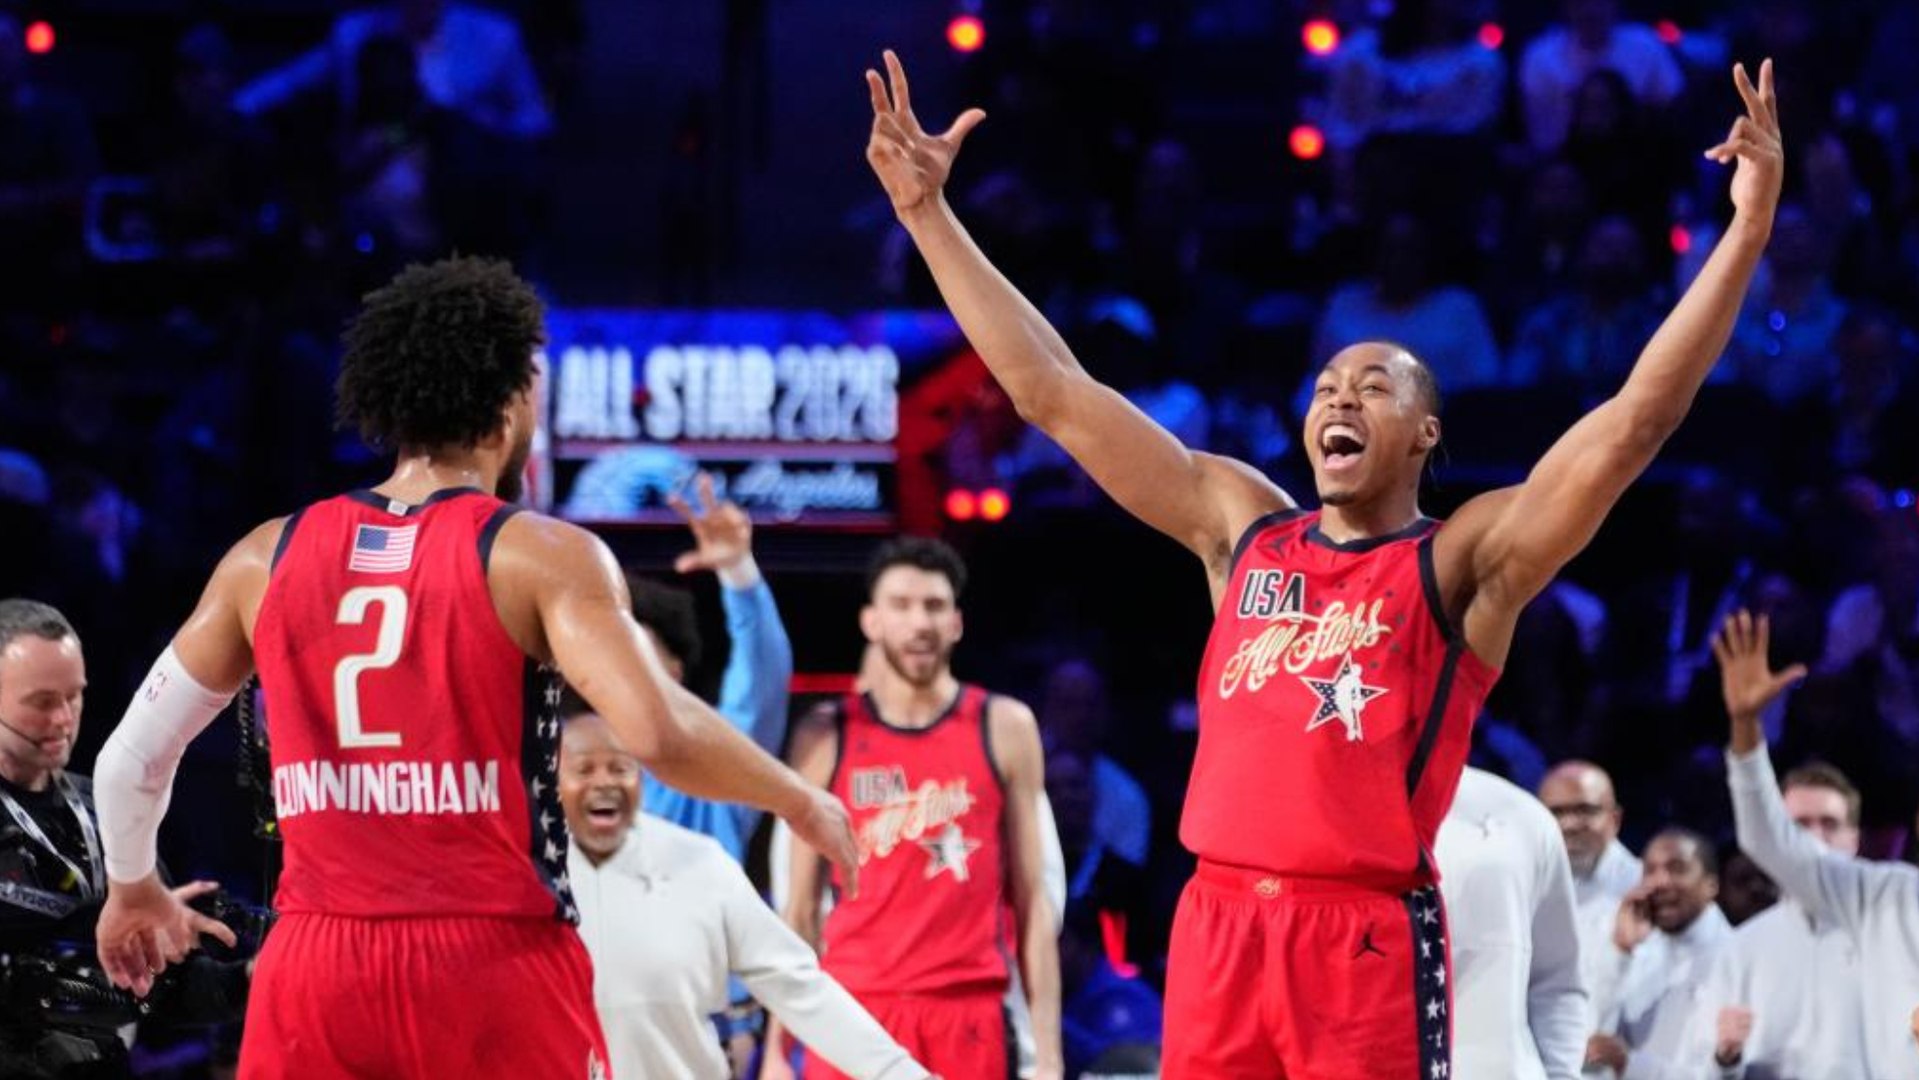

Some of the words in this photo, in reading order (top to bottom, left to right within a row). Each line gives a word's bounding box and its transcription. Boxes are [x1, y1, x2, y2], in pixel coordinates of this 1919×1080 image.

[556, 345, 639, 439] ALL
[1238, 569, 1305, 623] USA
[333, 585, 408, 749] 2
[1219, 622, 1300, 699] All
[1272, 598, 1392, 674] Stars
[274, 760, 500, 819] CUNNINGHAM
[849, 765, 908, 810] USA
